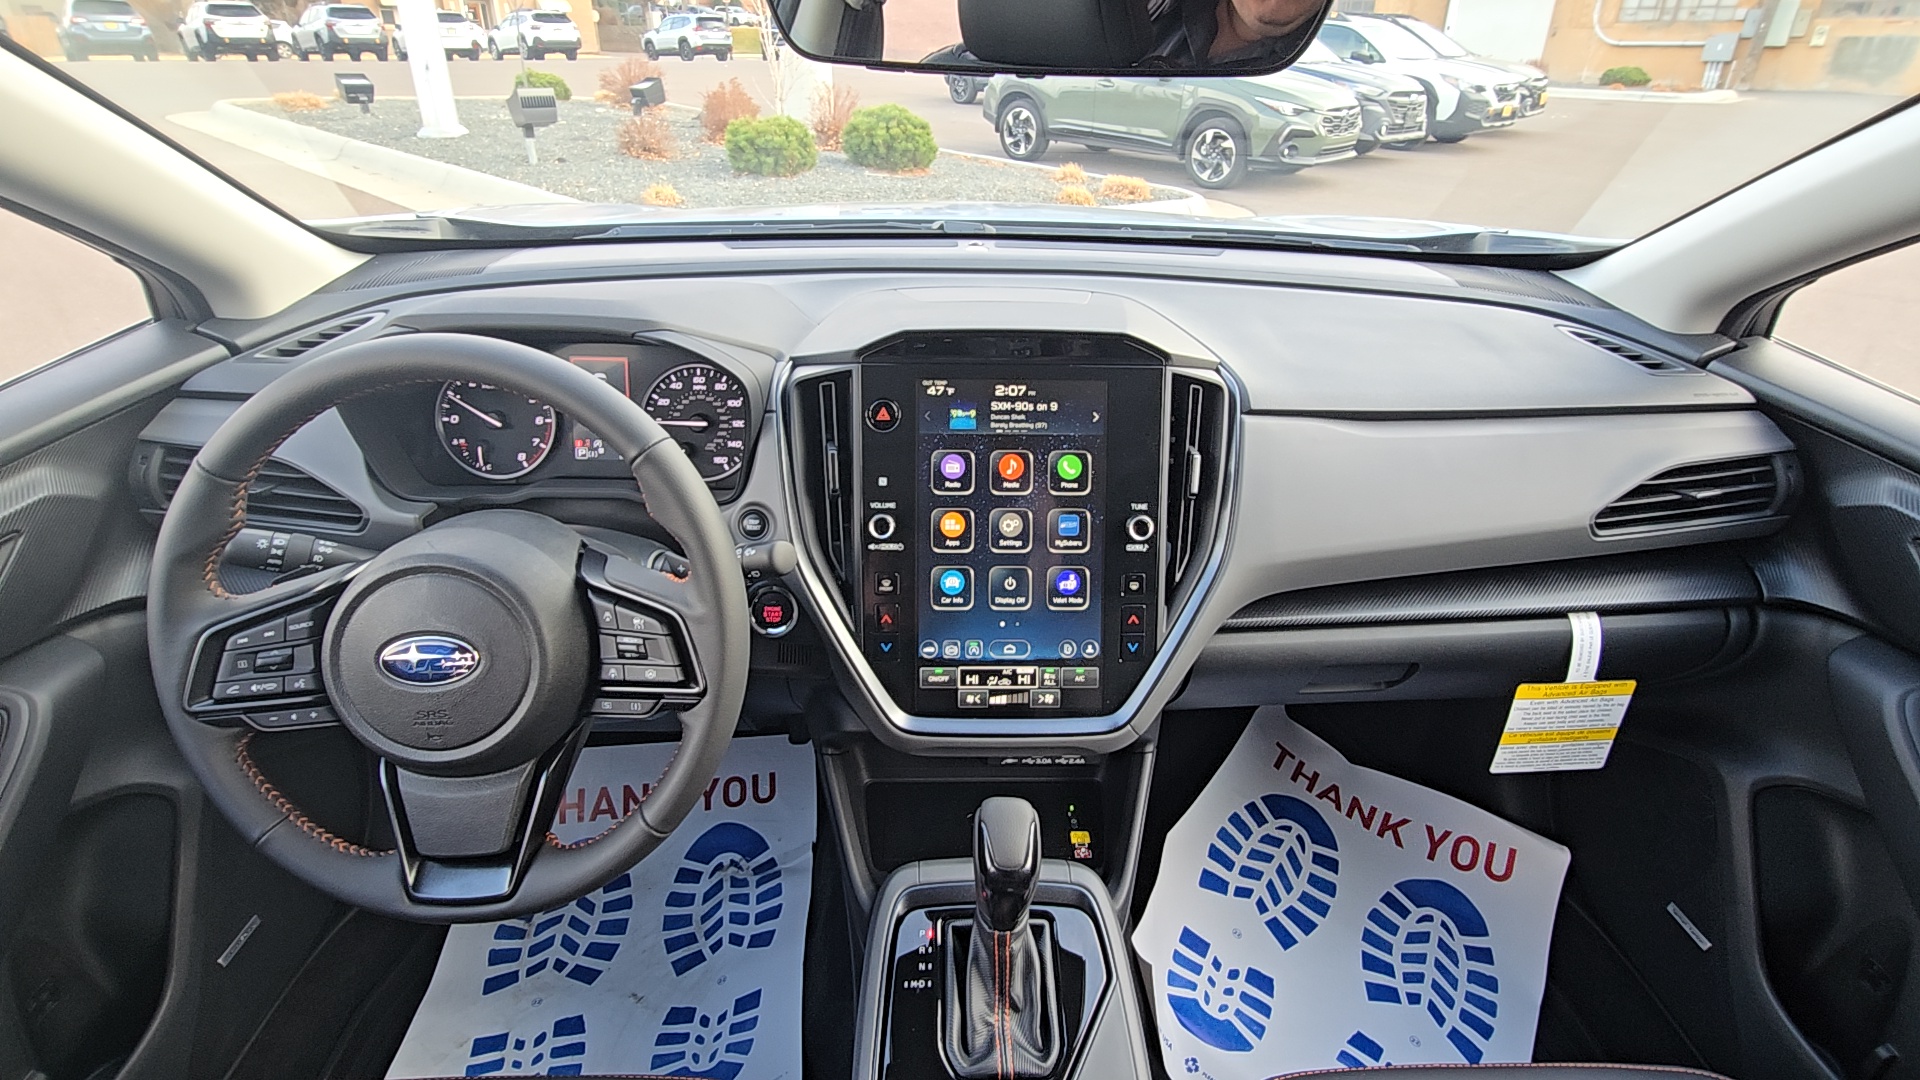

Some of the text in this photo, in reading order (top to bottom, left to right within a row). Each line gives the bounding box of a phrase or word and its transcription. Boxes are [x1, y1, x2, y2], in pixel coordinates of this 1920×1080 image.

[669, 382, 683, 390] 40
[994, 384, 1027, 397] 2:07
[990, 401, 1059, 411] SXM-90s on 9
[450, 415, 460, 424] 0
[534, 416, 544, 425] 6
[532, 438, 541, 447] 7
[945, 481, 962, 489] Radio
[1003, 481, 1020, 489] Media
[1060, 481, 1079, 489] Phone
[1130, 502, 1149, 510] TUNE
[945, 539, 961, 547] Apps
[998, 538, 1023, 547] Settings
[940, 596, 964, 604] Car Info
[994, 596, 1026, 605] Display Off
[1052, 596, 1084, 604] Valet Mode
[288, 620, 315, 631] SOURCE
[965, 674, 980, 685] HI
[1017, 675, 1031, 685] HI
[1580, 682, 1612, 690] Equipped
[1542, 690, 1576, 698] Advanced
[1590, 689, 1608, 697] Bags
[416, 709, 449, 719] SRS
[558, 771, 777, 824] HAN YOU
[1272, 741, 1518, 882] THANK YOU
[919, 929, 926, 938] P
[919, 946, 926, 955] R
[919, 963, 926, 971] N
